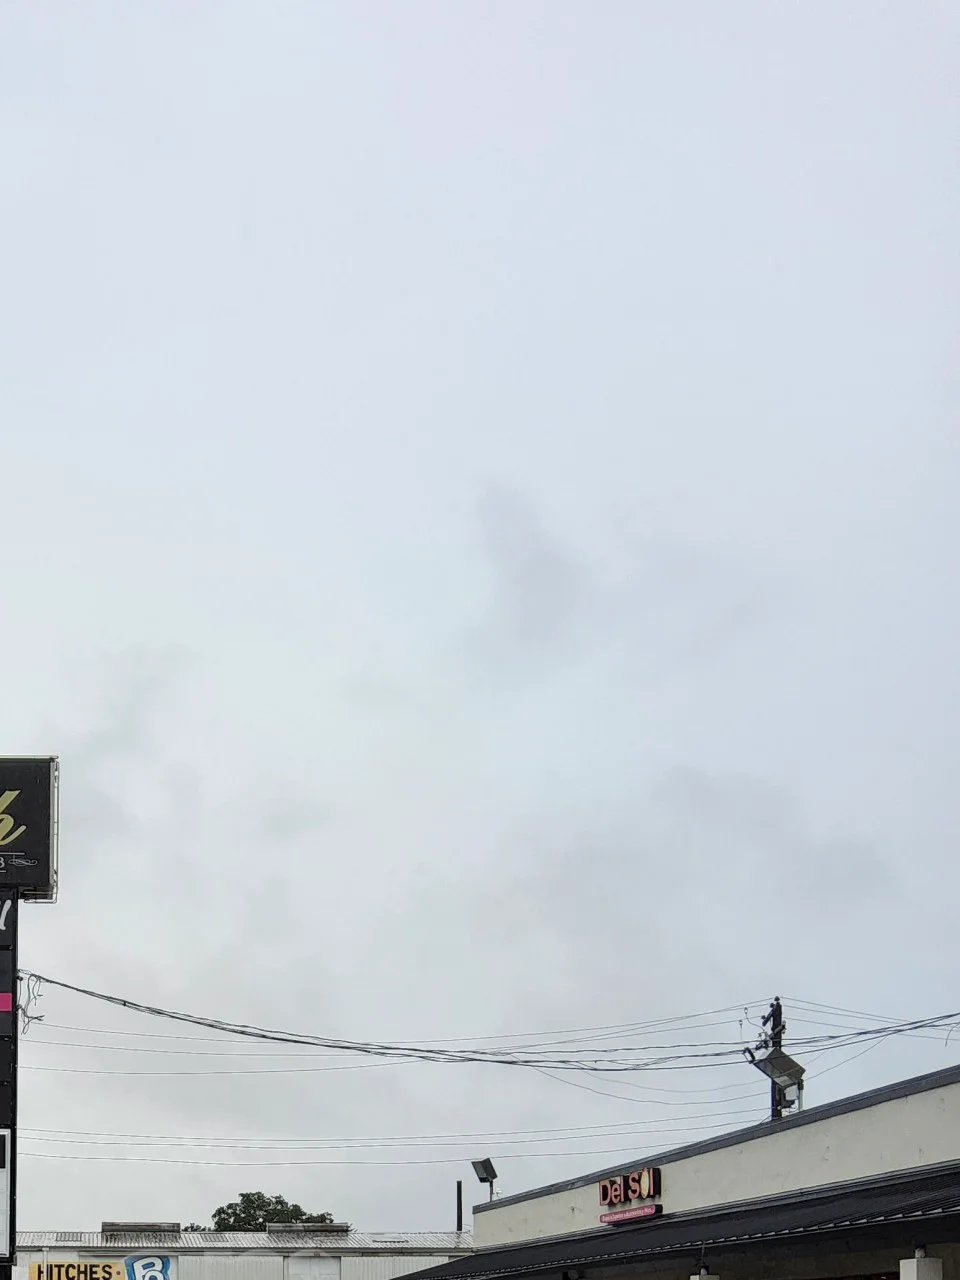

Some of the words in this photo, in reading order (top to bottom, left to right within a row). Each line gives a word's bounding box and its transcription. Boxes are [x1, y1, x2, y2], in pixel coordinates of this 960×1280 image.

[599, 1175, 624, 1206] Del
[628, 1167, 653, 1199] Sol
[37, 1263, 113, 1280] HITCHES
